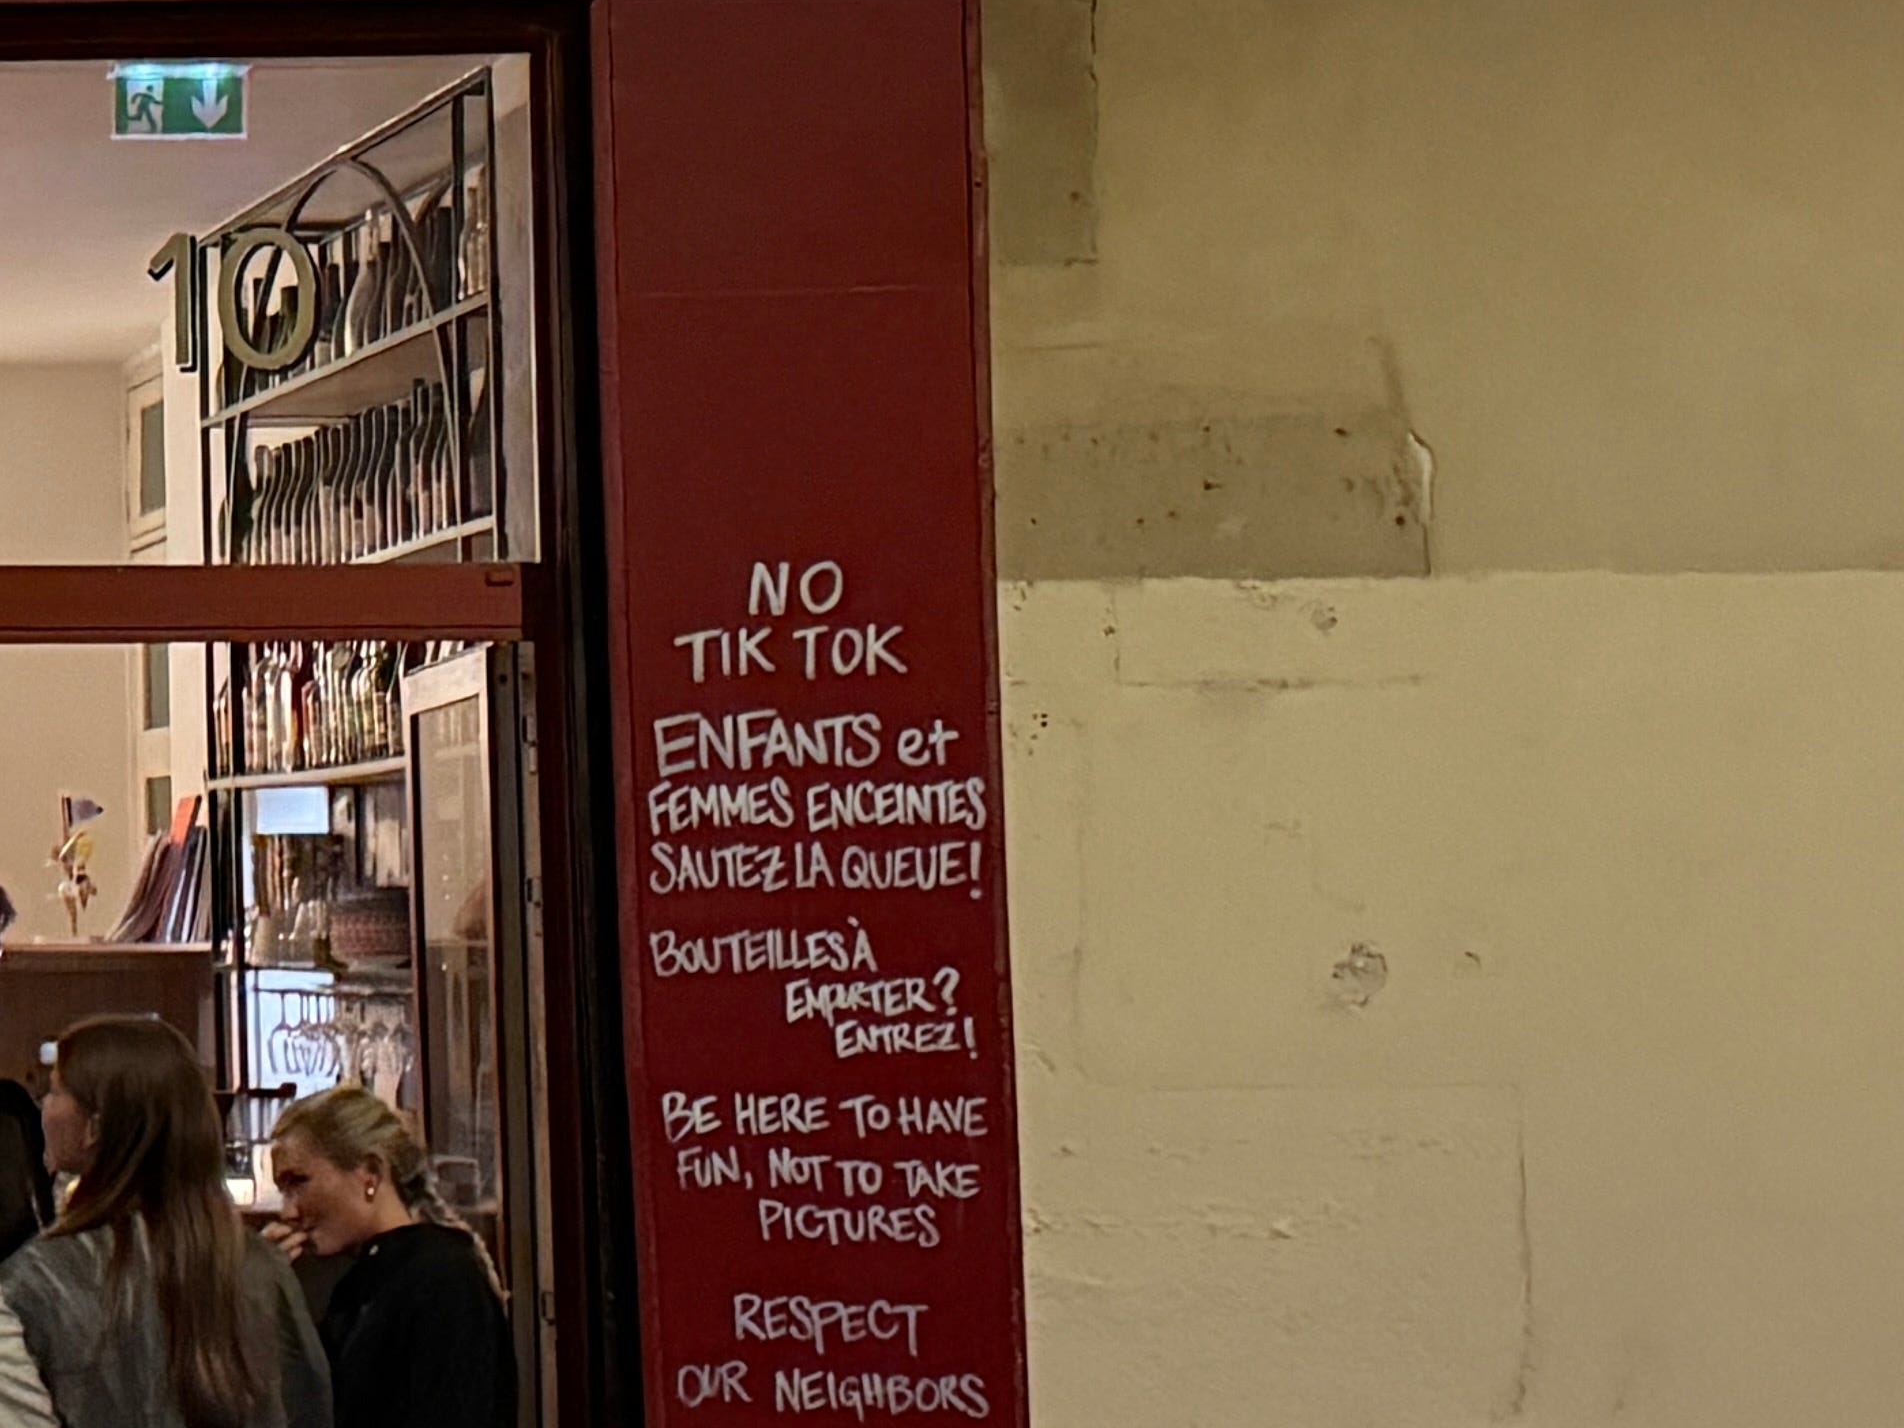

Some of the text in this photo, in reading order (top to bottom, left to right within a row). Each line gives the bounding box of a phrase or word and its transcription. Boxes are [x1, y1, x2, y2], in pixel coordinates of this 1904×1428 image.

[149, 227, 318, 371] 10
[748, 560, 843, 616] NO
[674, 623, 908, 683] TIK TOK
[653, 709, 959, 778] ENFANTS et
[648, 776, 988, 836] FEMMES ENCEINTES
[649, 840, 982, 900] SAUTEZ LA QUEUE!
[649, 916, 878, 977] BOUTEILLES À
[662, 1091, 988, 1142] BE HERE TO HAVE
[677, 1147, 980, 1198] FUN, NOT TO TAKE
[758, 1199, 940, 1248] PICTURES
[733, 1293, 928, 1357] RESPECT
[677, 1361, 989, 1422] OUR NEIGHBORS
